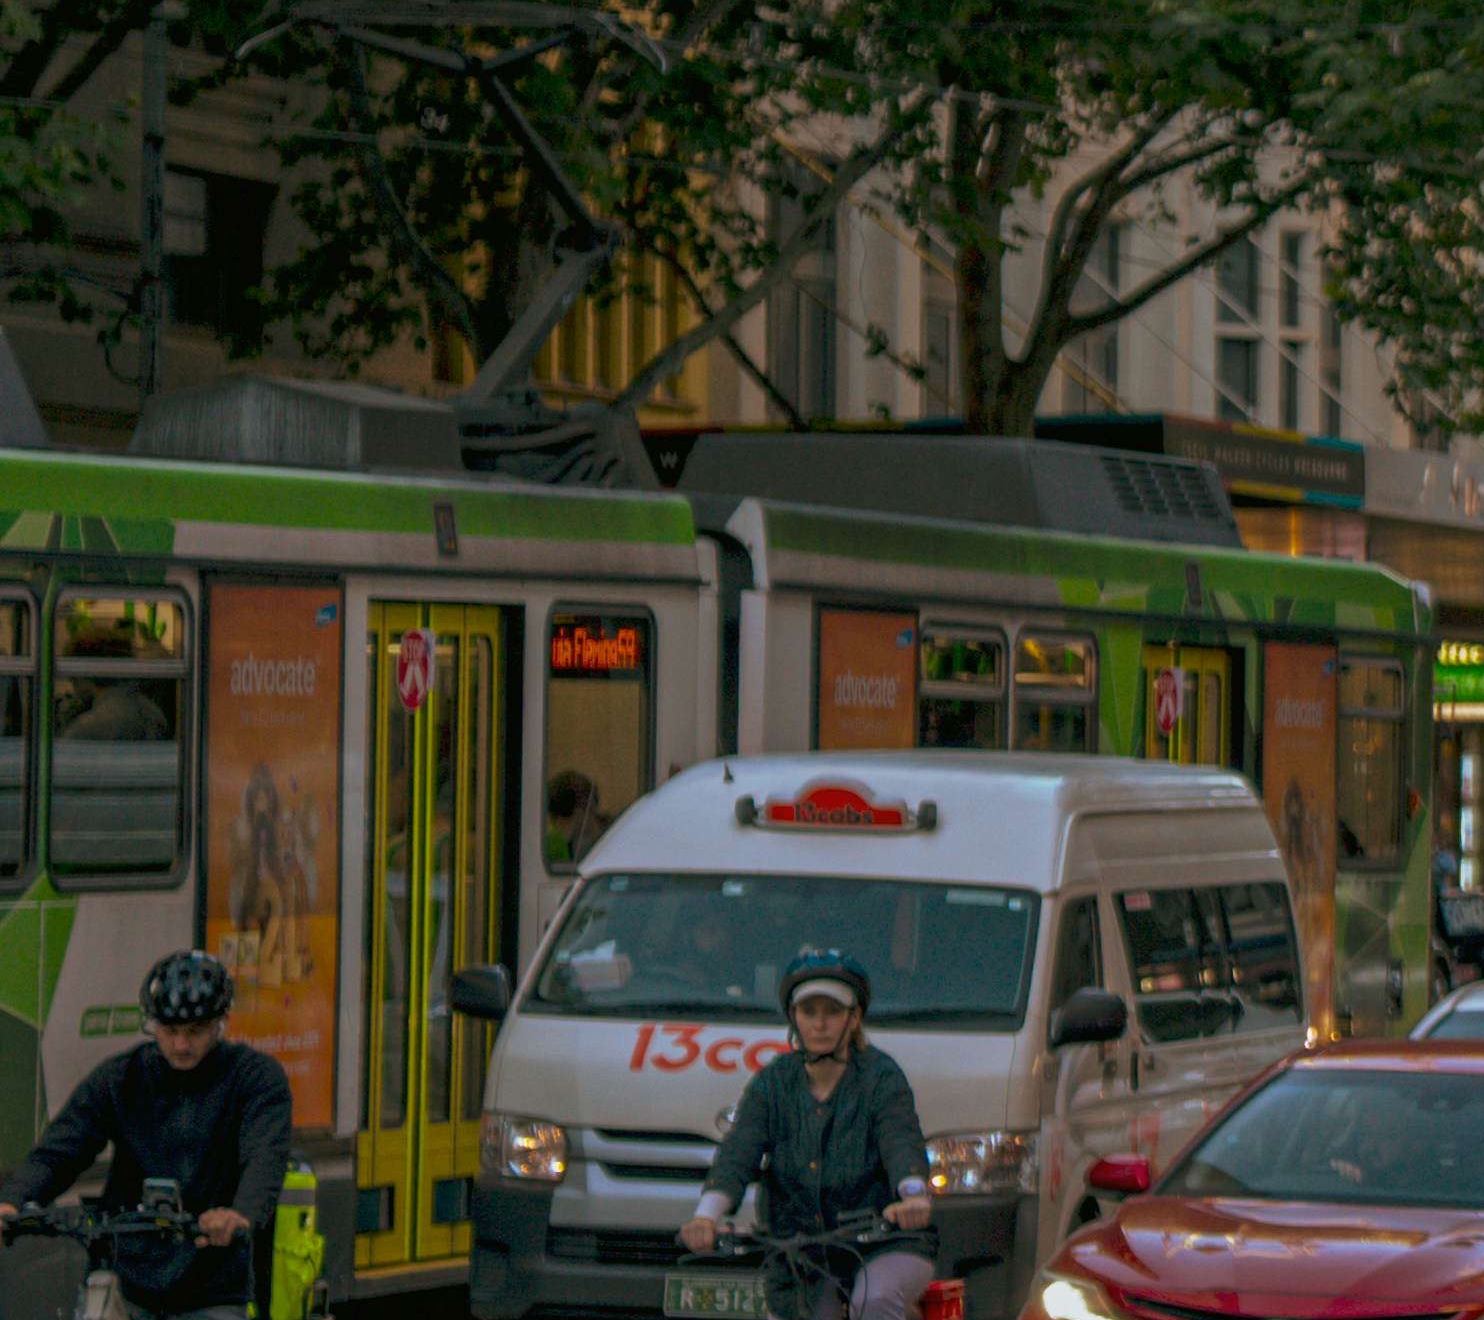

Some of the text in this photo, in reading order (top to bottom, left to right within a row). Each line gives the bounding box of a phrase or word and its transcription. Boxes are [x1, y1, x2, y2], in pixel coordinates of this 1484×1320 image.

[230, 651, 316, 697] advocate
[834, 670, 897, 709] advocate
[794, 801, 874, 824] 13cabs
[629, 1021, 793, 1075] 13ca
[680, 1288, 694, 1311] R
